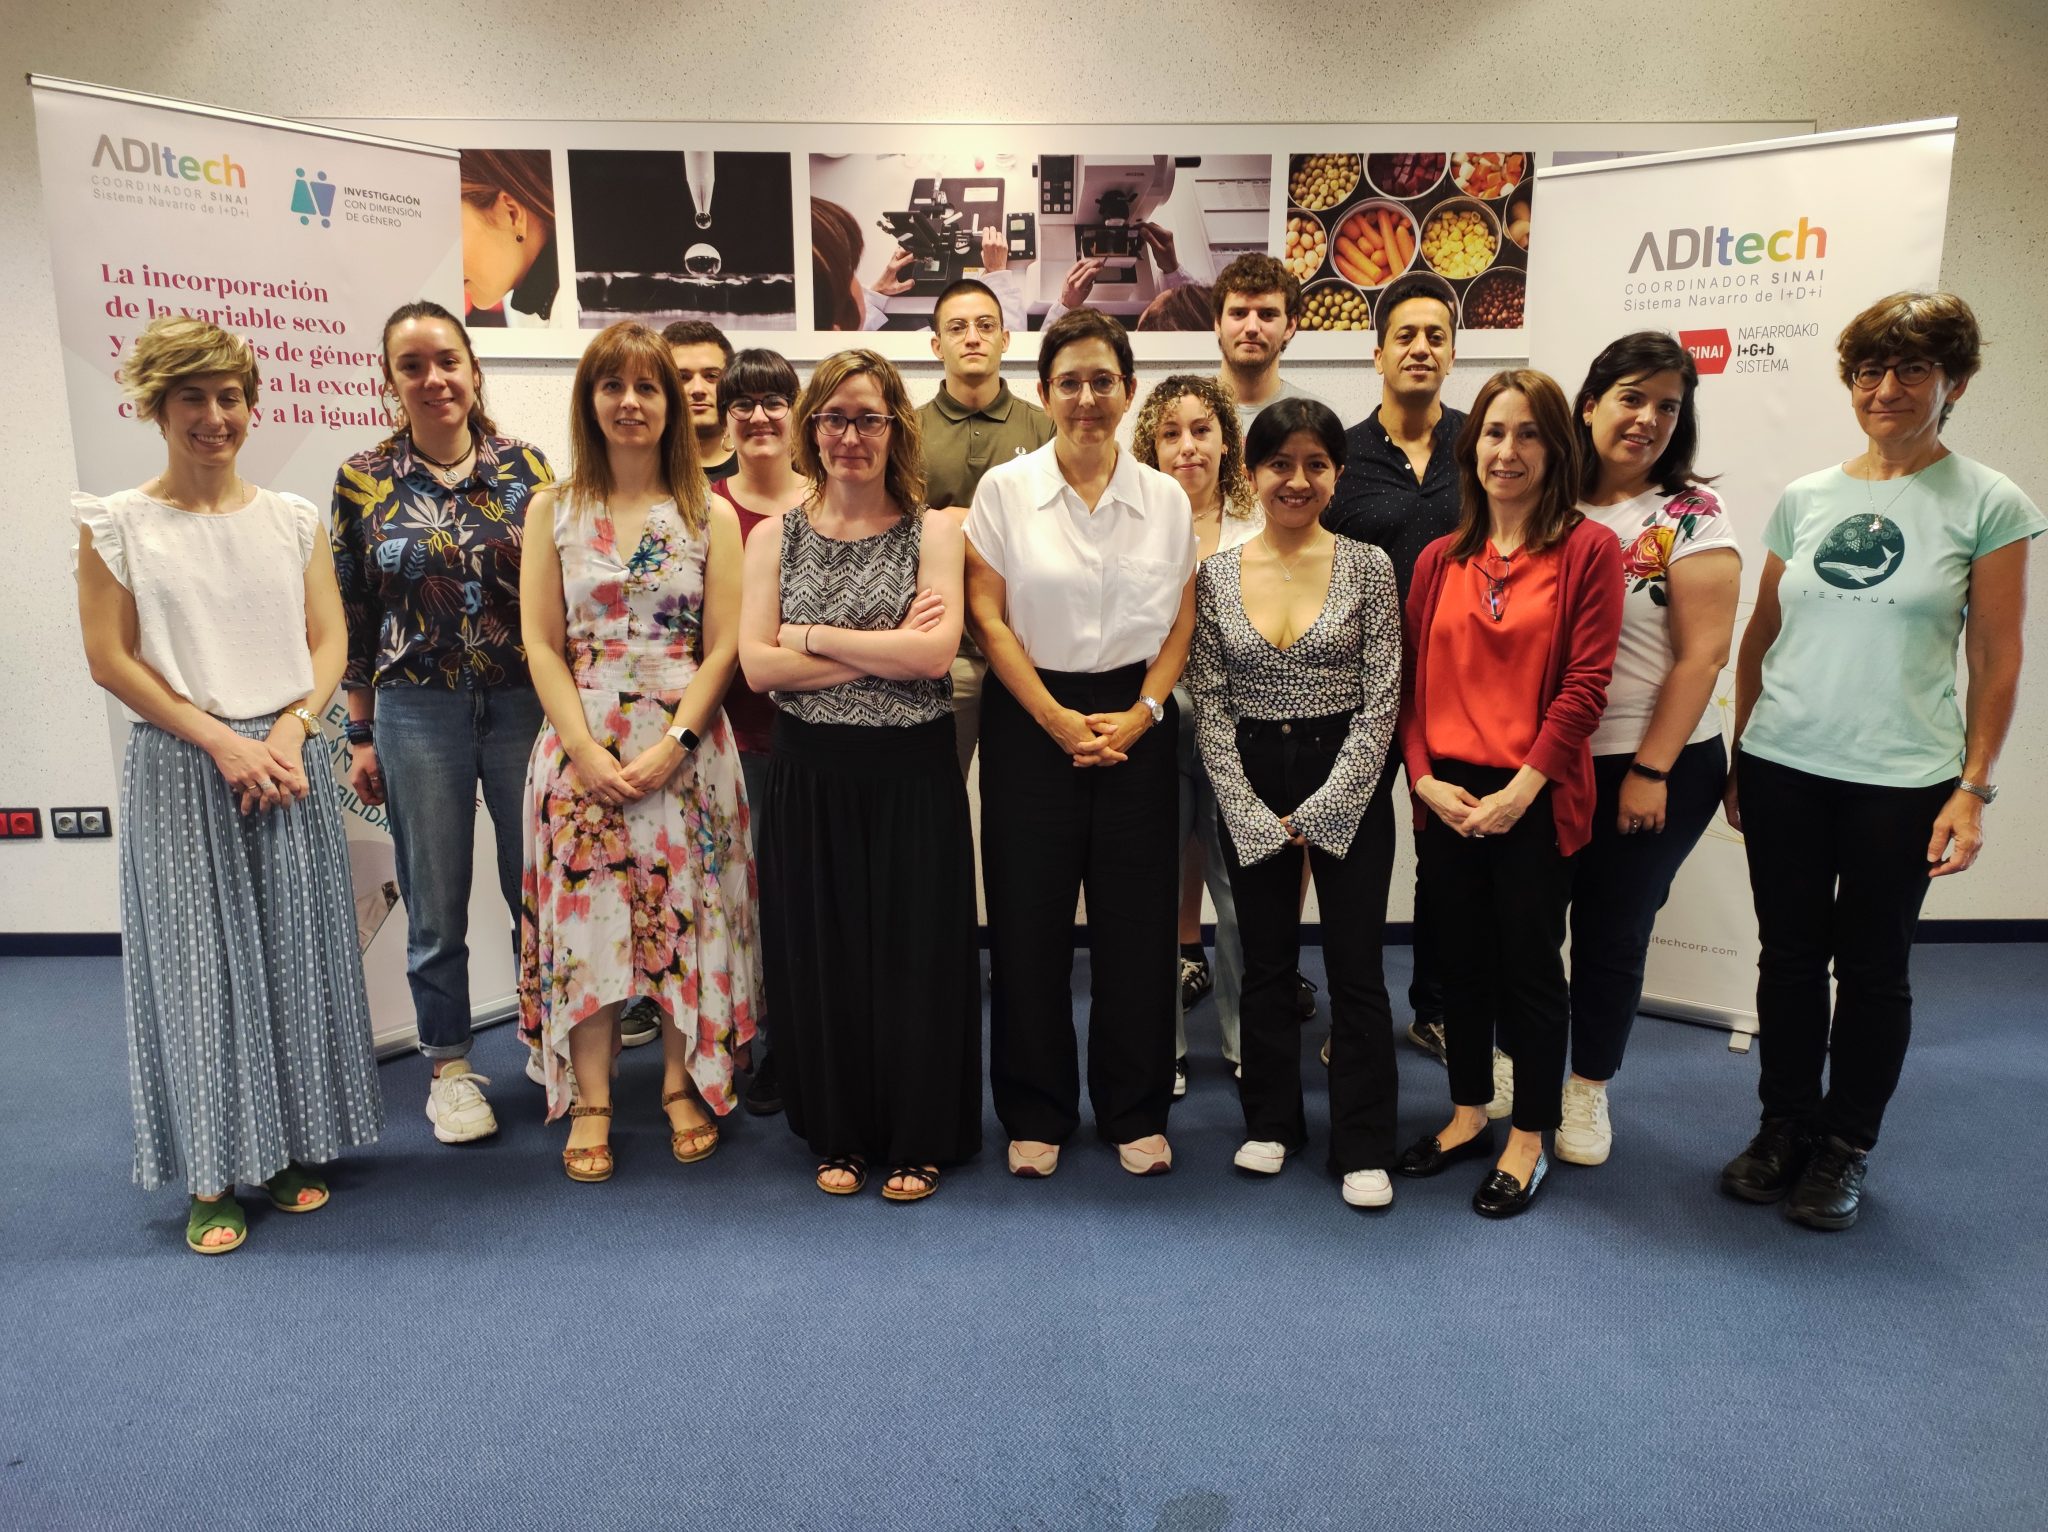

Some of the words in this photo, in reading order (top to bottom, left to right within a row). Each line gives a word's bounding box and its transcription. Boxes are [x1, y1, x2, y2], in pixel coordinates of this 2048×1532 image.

[91, 134, 246, 188] ADItech
[91, 175, 202, 199] COORDINADOR
[210, 191, 248, 205] SINAI
[93, 188, 143, 203] Sistema
[149, 196, 196, 211] Navarro
[201, 201, 214, 214] de
[344, 186, 420, 206] INVESTIGACIÓN
[344, 199, 367, 210] CON
[369, 203, 422, 218] DIMENSIÓN
[346, 212, 359, 222] DE
[362, 214, 402, 228] GÉNERO
[1628, 216, 1828, 274] ADItech
[101, 263, 135, 285] La
[142, 264, 329, 303] incorporación
[1625, 274, 1760, 295] COORDINADOR
[1771, 269, 1825, 285] SINAI
[1624, 297, 1681, 311] Sistema
[1689, 294, 1748, 307] Navarro
[1755, 290, 1773, 303] de
[1781, 286, 1823, 300] I+D+i
[105, 295, 140, 319] de
[147, 298, 172, 320] la
[180, 305, 286, 330] variable
[292, 315, 346, 335] sexo
[1738, 323, 1819, 340] NAFARROAKO
[109, 335, 125, 357] y
[275, 341, 303, 362] de
[1688, 344, 1724, 359] SINAI
[1737, 343, 1775, 357] I+G+b
[1736, 359, 1789, 374] SISTEMA
[270, 376, 284, 392] a
[290, 372, 311, 393] la
[251, 406, 264, 428] y
[273, 408, 286, 423] a
[292, 403, 314, 424] la
[320, 404, 394, 430] iguald
[1650, 935, 1738, 957] itechcorp.com
